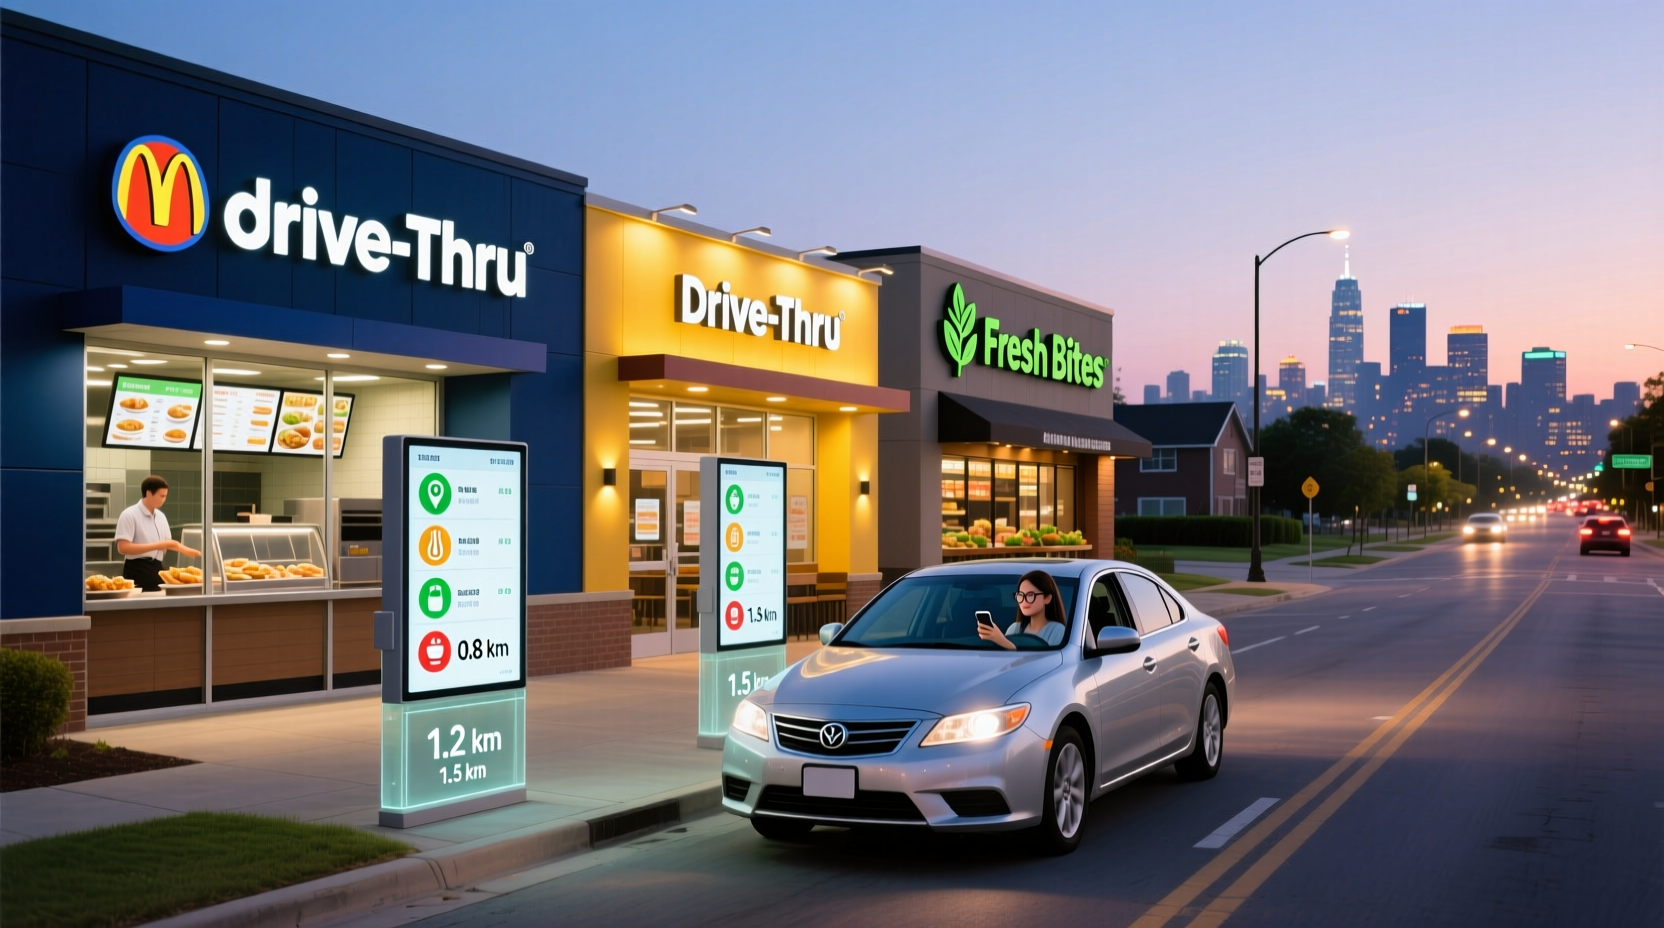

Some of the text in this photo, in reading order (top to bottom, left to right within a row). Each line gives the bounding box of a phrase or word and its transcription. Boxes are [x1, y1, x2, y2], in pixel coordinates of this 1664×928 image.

[224, 177, 527, 298] drive-Thru
[682, 273, 841, 351] Drive-Thru
[984, 316, 1104, 389] Fresh Bites
[457, 638, 509, 661] 0.8 km
[728, 670, 751, 697] 1.5
[427, 723, 502, 760] 1.2 km
[439, 762, 487, 785] 1.5 km
